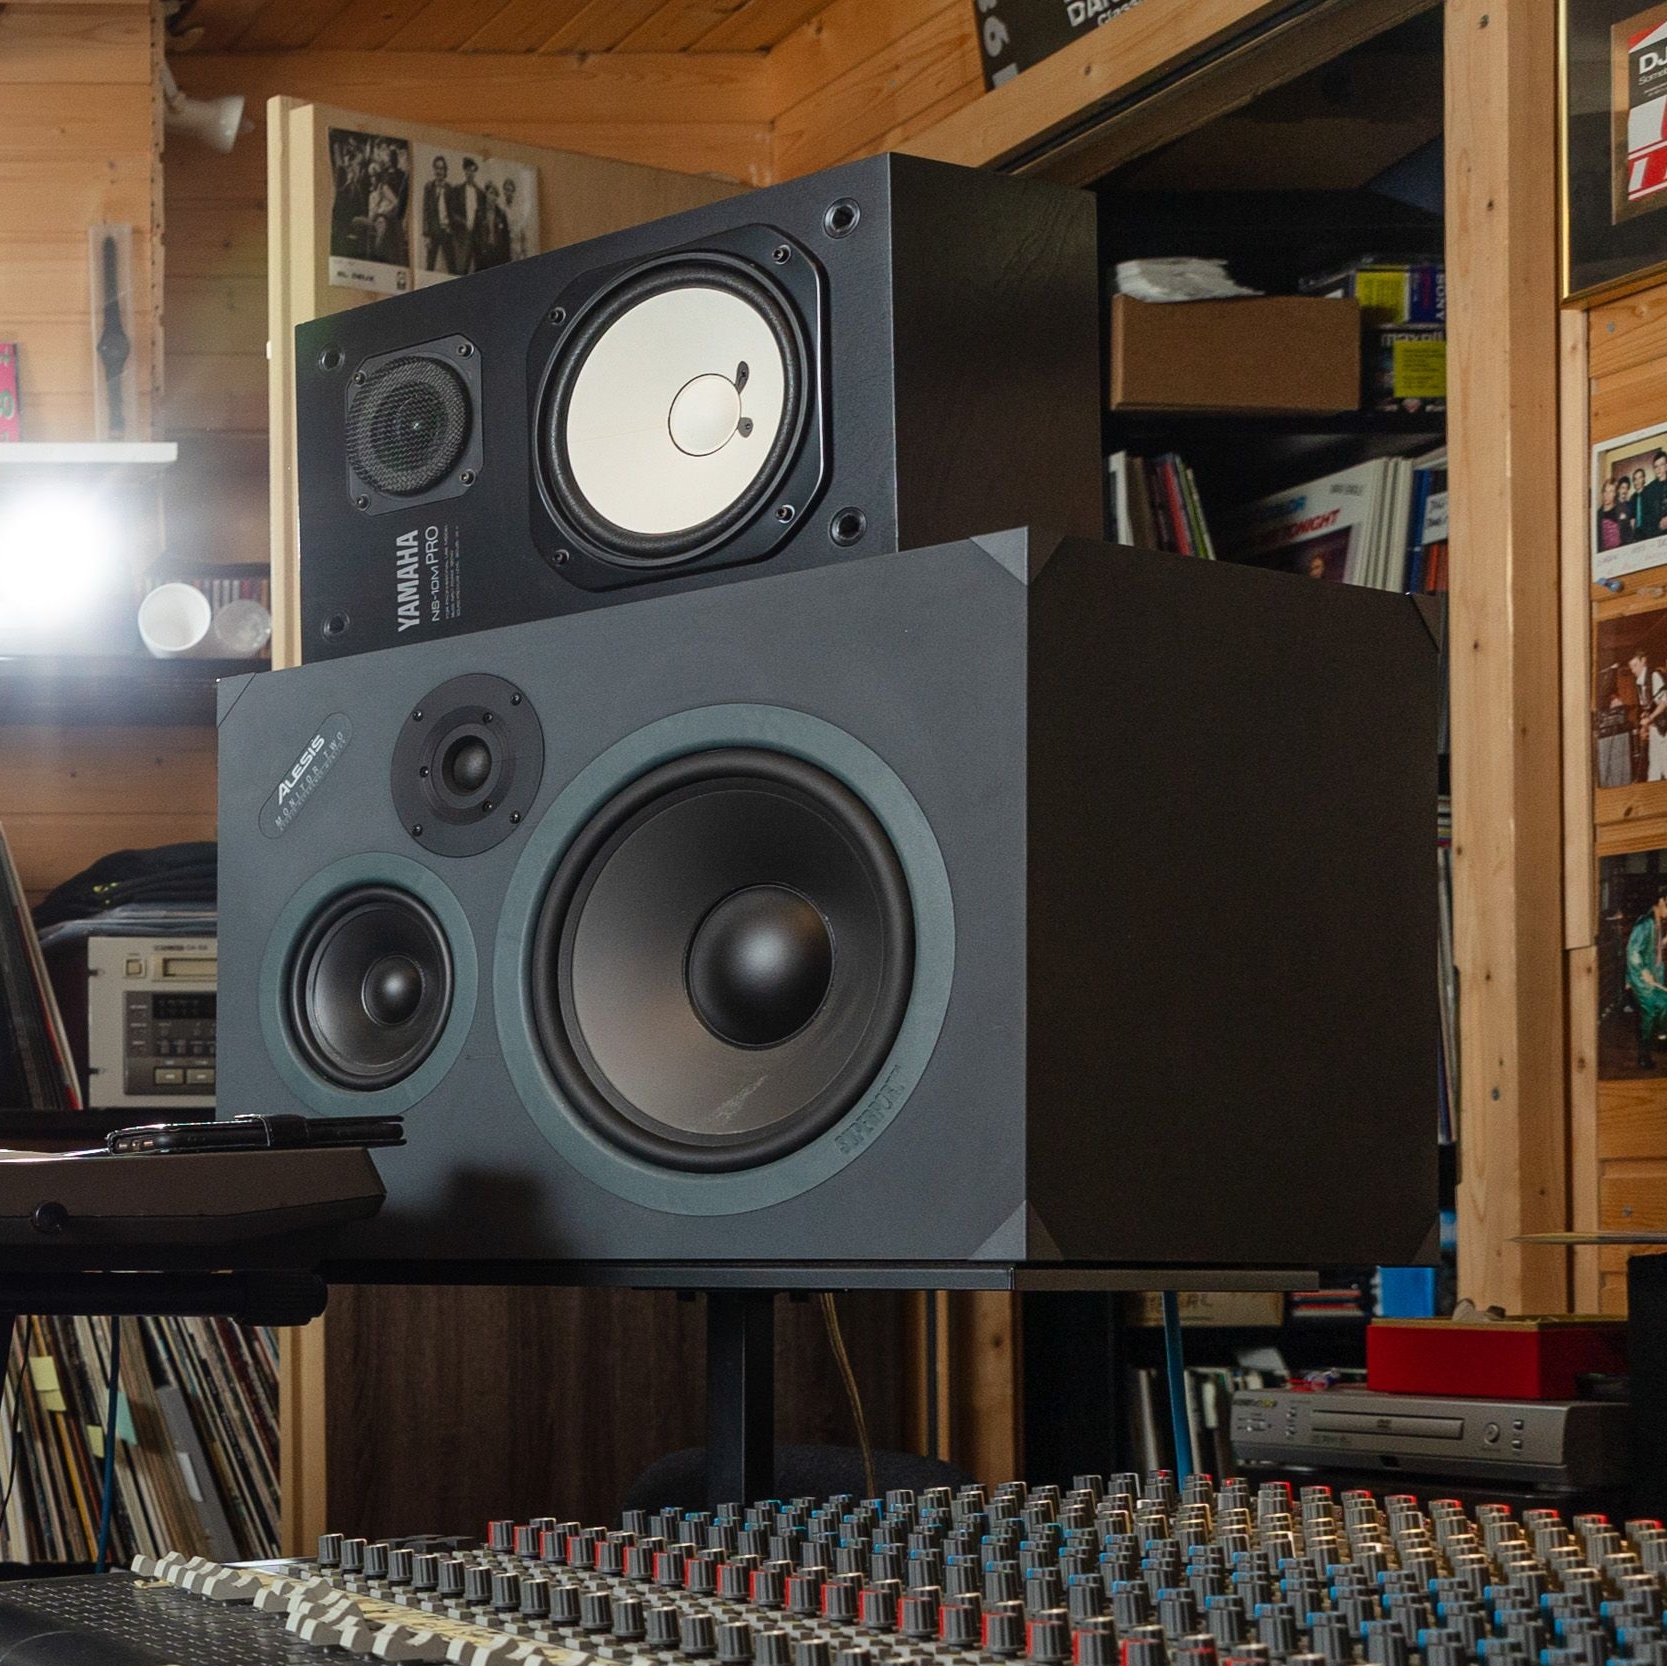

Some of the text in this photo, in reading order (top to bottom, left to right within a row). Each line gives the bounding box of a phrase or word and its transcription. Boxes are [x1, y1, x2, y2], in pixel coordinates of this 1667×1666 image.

[1435, 272, 1444, 320] SONY
[396, 529, 420, 632] YAMAHA
[425, 525, 440, 621] NS-10M PRO
[275, 765, 321, 828] MONITOR
[323, 731, 345, 760] TWO
[278, 733, 325, 805] ALESIS
